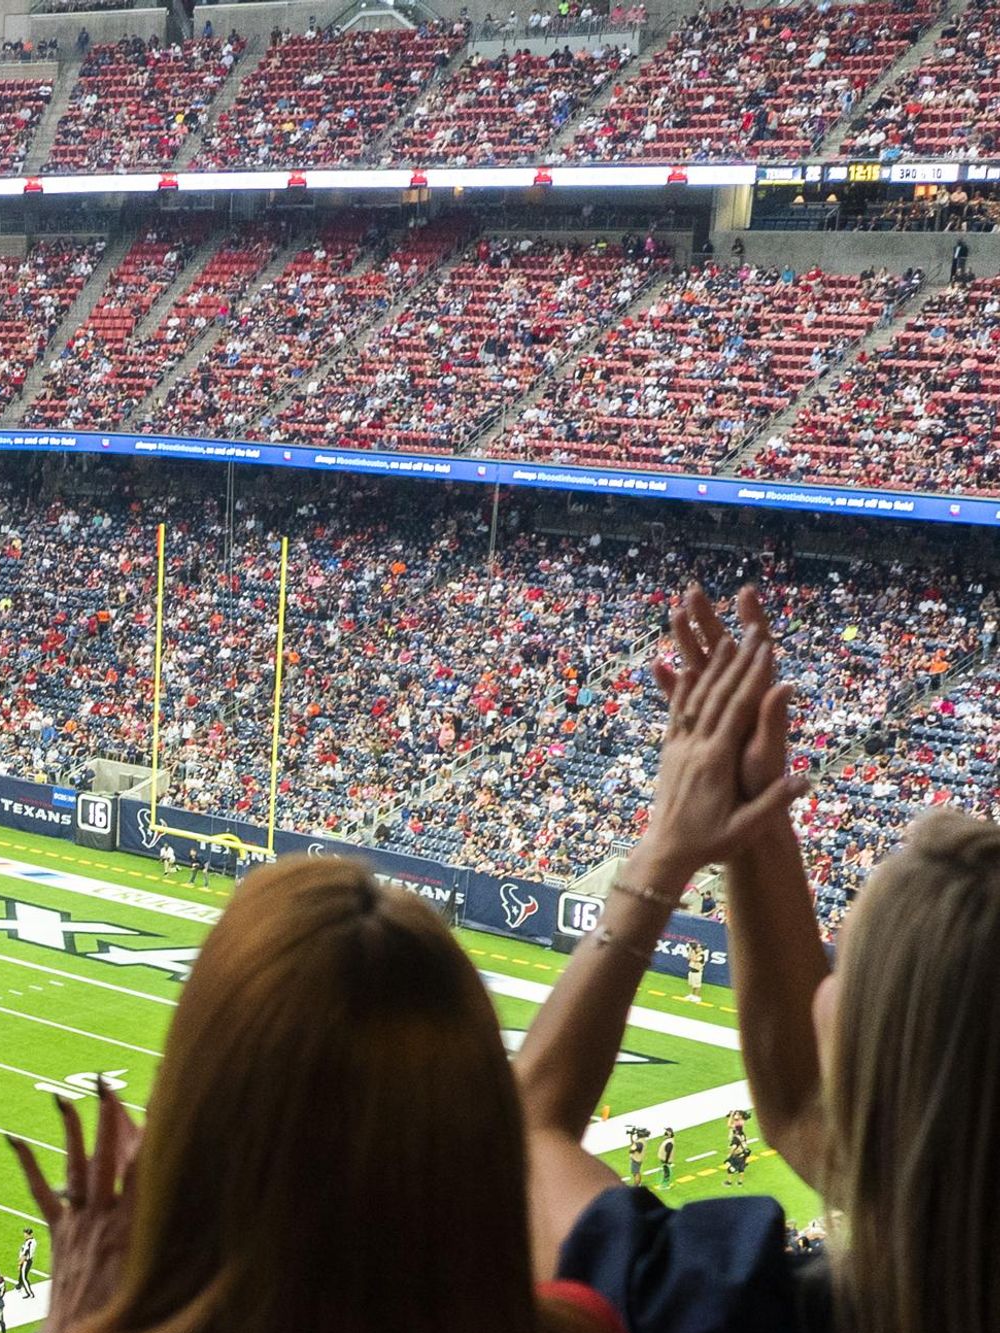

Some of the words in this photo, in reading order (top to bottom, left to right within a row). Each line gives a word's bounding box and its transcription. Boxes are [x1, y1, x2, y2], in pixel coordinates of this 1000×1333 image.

[0, 798, 72, 825] TEXANS
[88, 802, 107, 828] 16
[572, 902, 598, 932] 16
